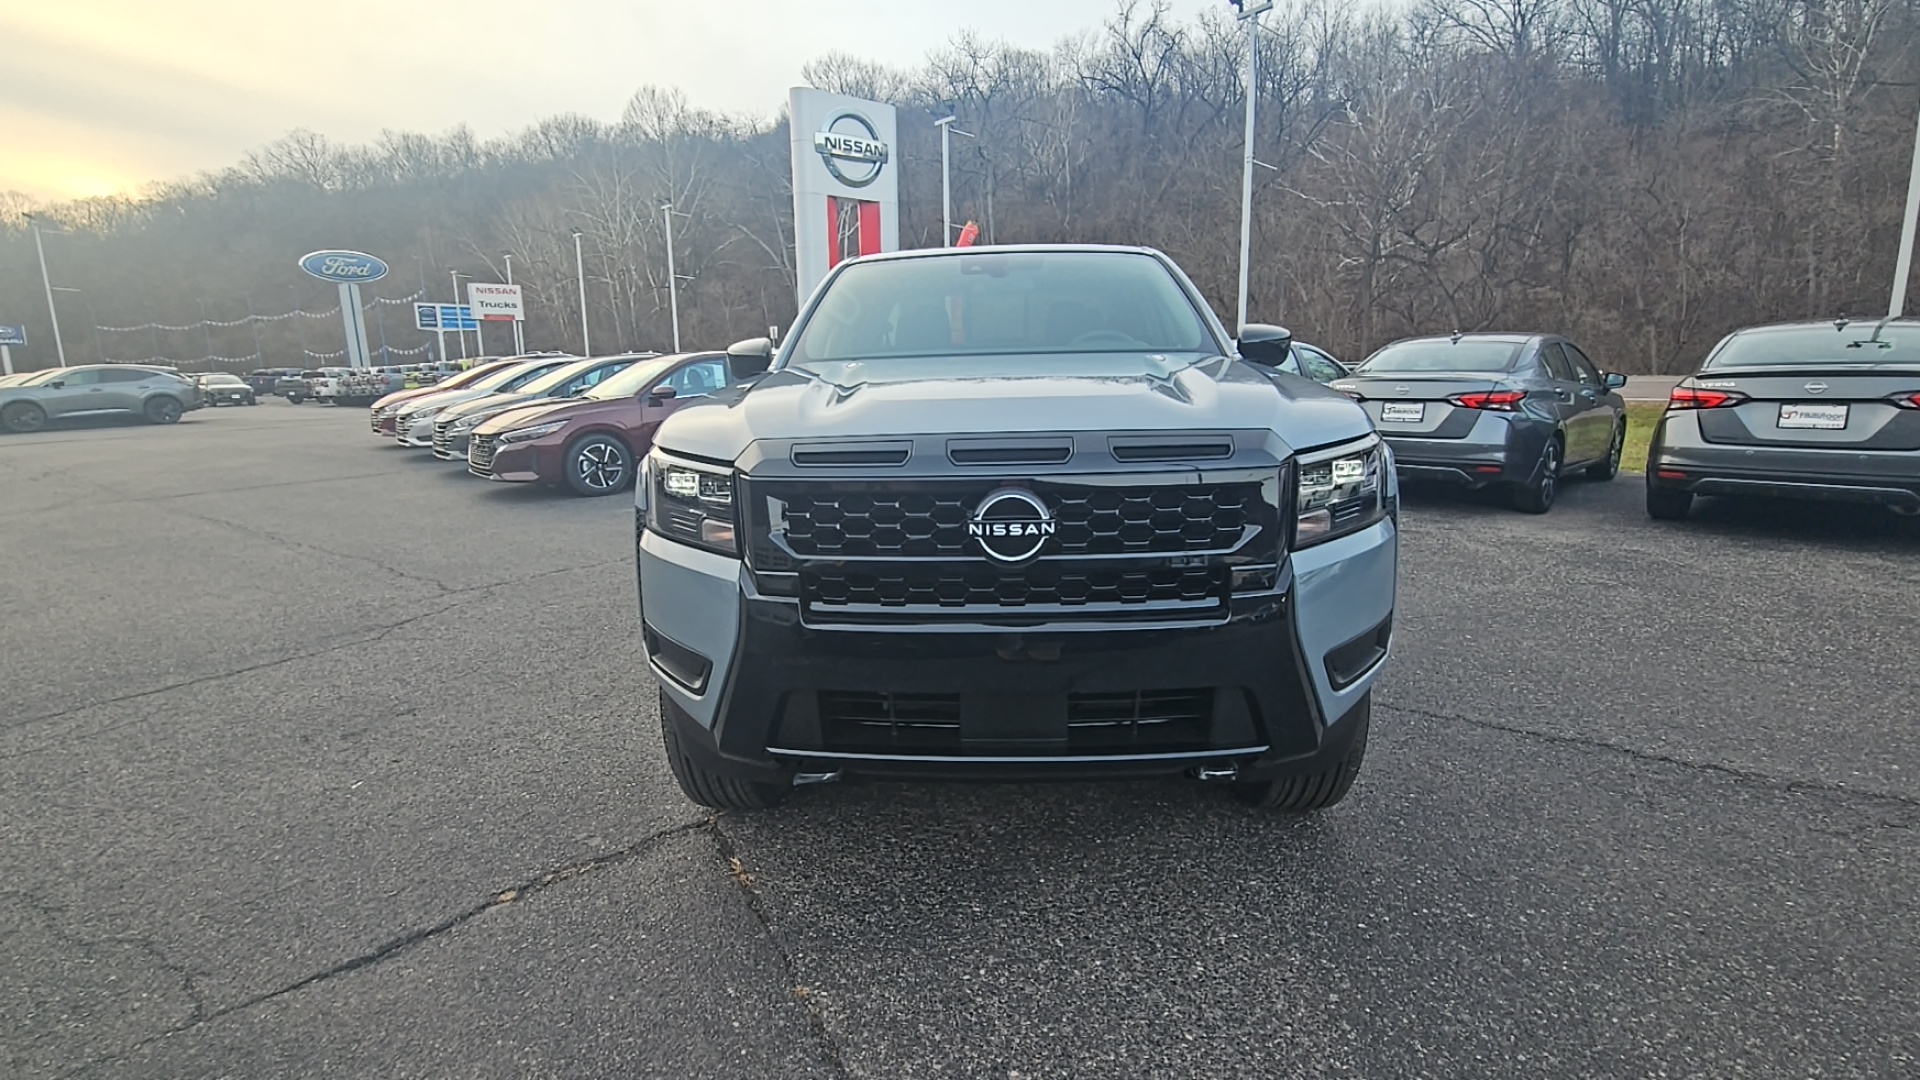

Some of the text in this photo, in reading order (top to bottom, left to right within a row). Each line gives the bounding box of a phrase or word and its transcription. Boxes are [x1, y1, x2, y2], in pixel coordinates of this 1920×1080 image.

[824, 136, 884, 157] NISSAN
[321, 256, 371, 276] Ford
[475, 286, 517, 295] NISSAN
[479, 300, 518, 309] Trucks
[968, 522, 1056, 537] NISSAN
